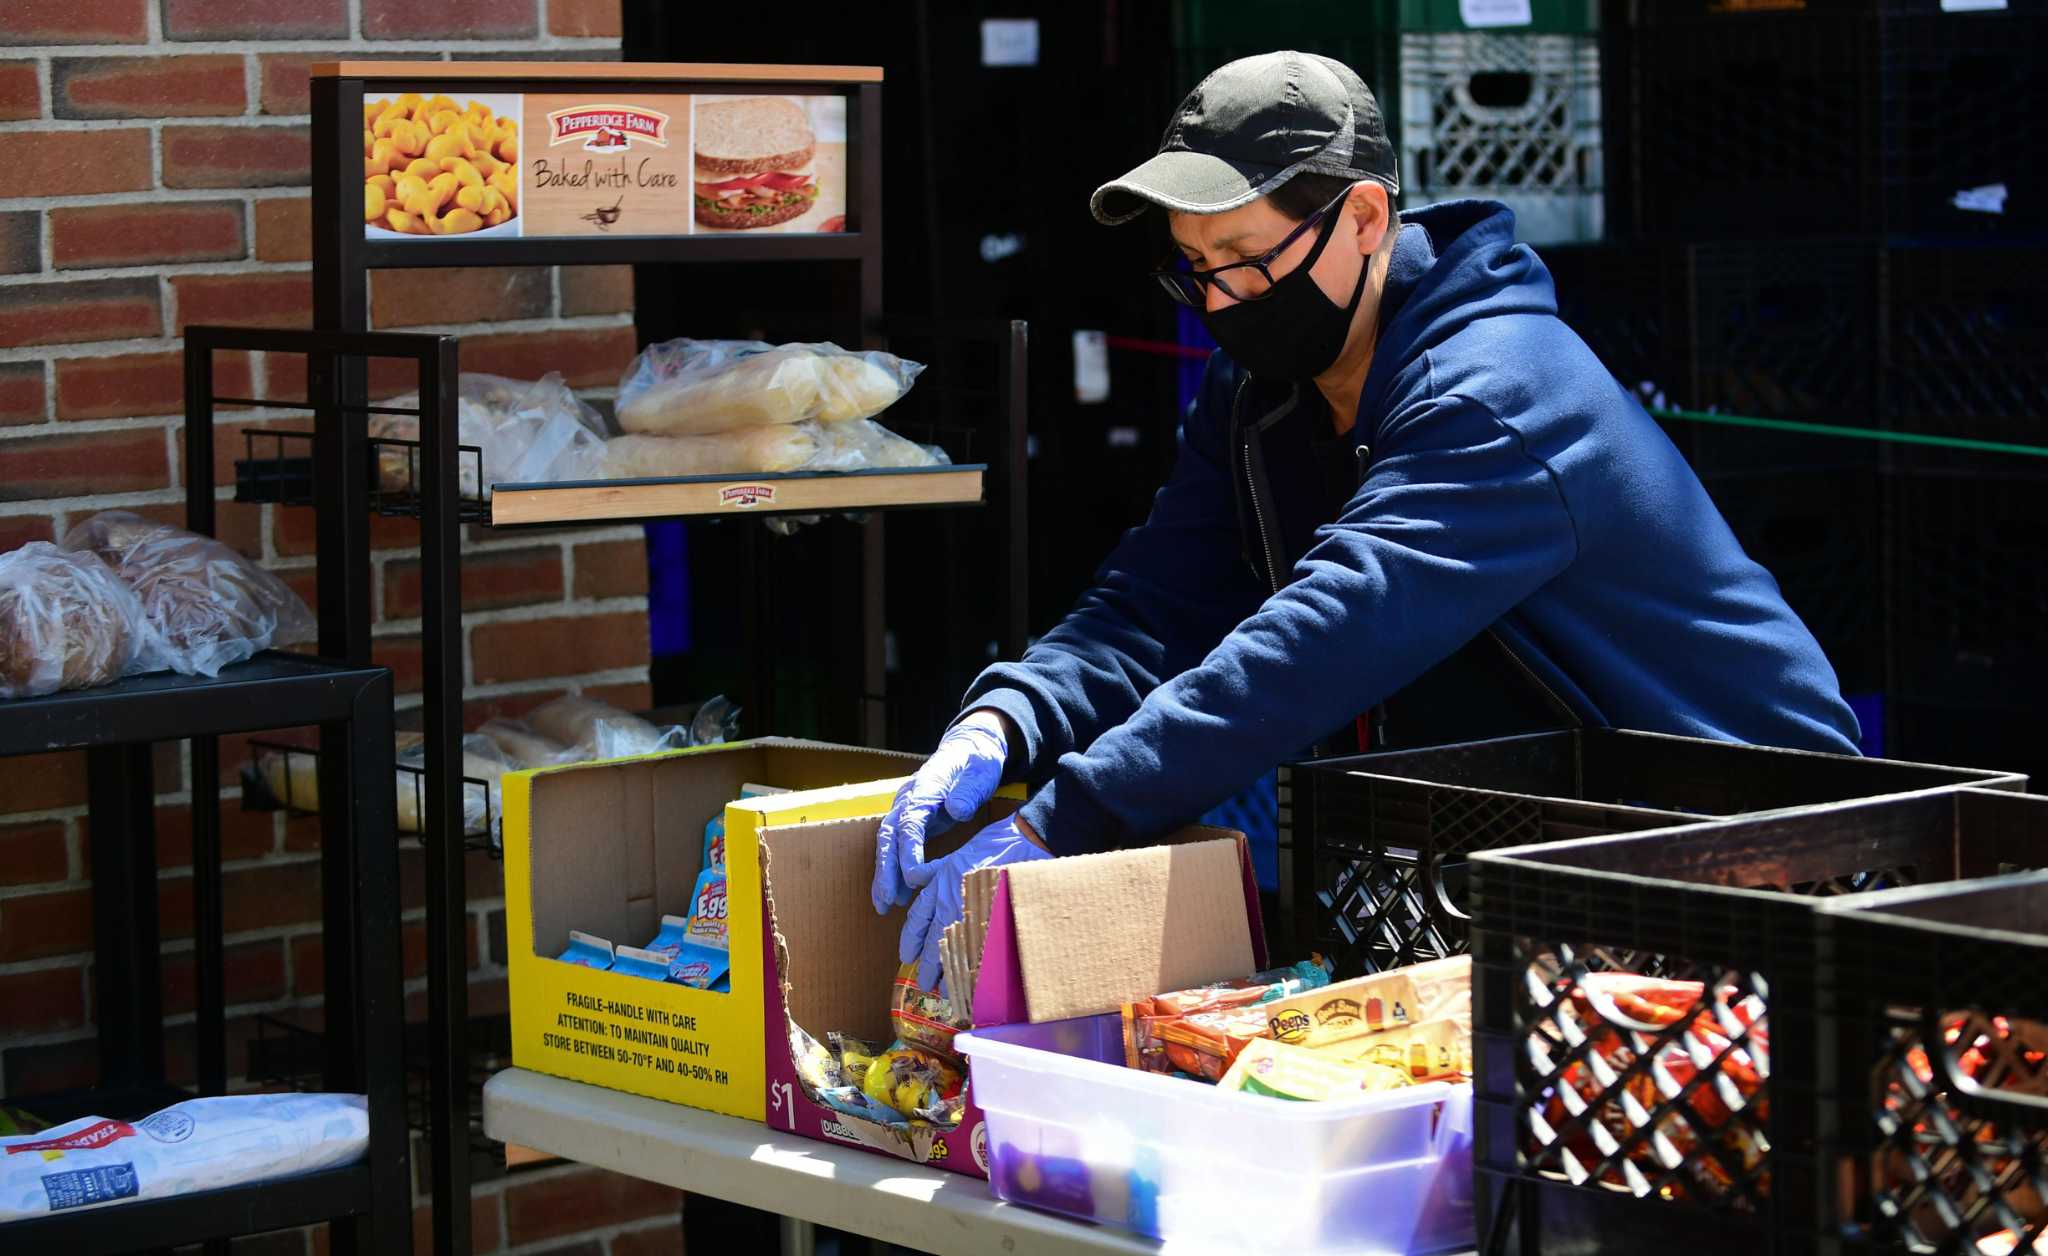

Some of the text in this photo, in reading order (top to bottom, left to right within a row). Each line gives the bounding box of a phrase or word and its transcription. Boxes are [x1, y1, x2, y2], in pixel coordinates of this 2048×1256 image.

[561, 114, 656, 133] PEPPERIDGE FARM
[532, 156, 680, 189] Baked with Care
[557, 1013, 710, 1057] ATTENTION: TO MAINTAIN QUALITY
[646, 1007, 670, 1025] WITH
[672, 1014, 697, 1031] CARE
[1269, 1014, 1310, 1036] Peeps
[543, 1033, 728, 1085] STORE BETWEEN 50-70°F AND 40-50% RH
[771, 1080, 796, 1130] $1
